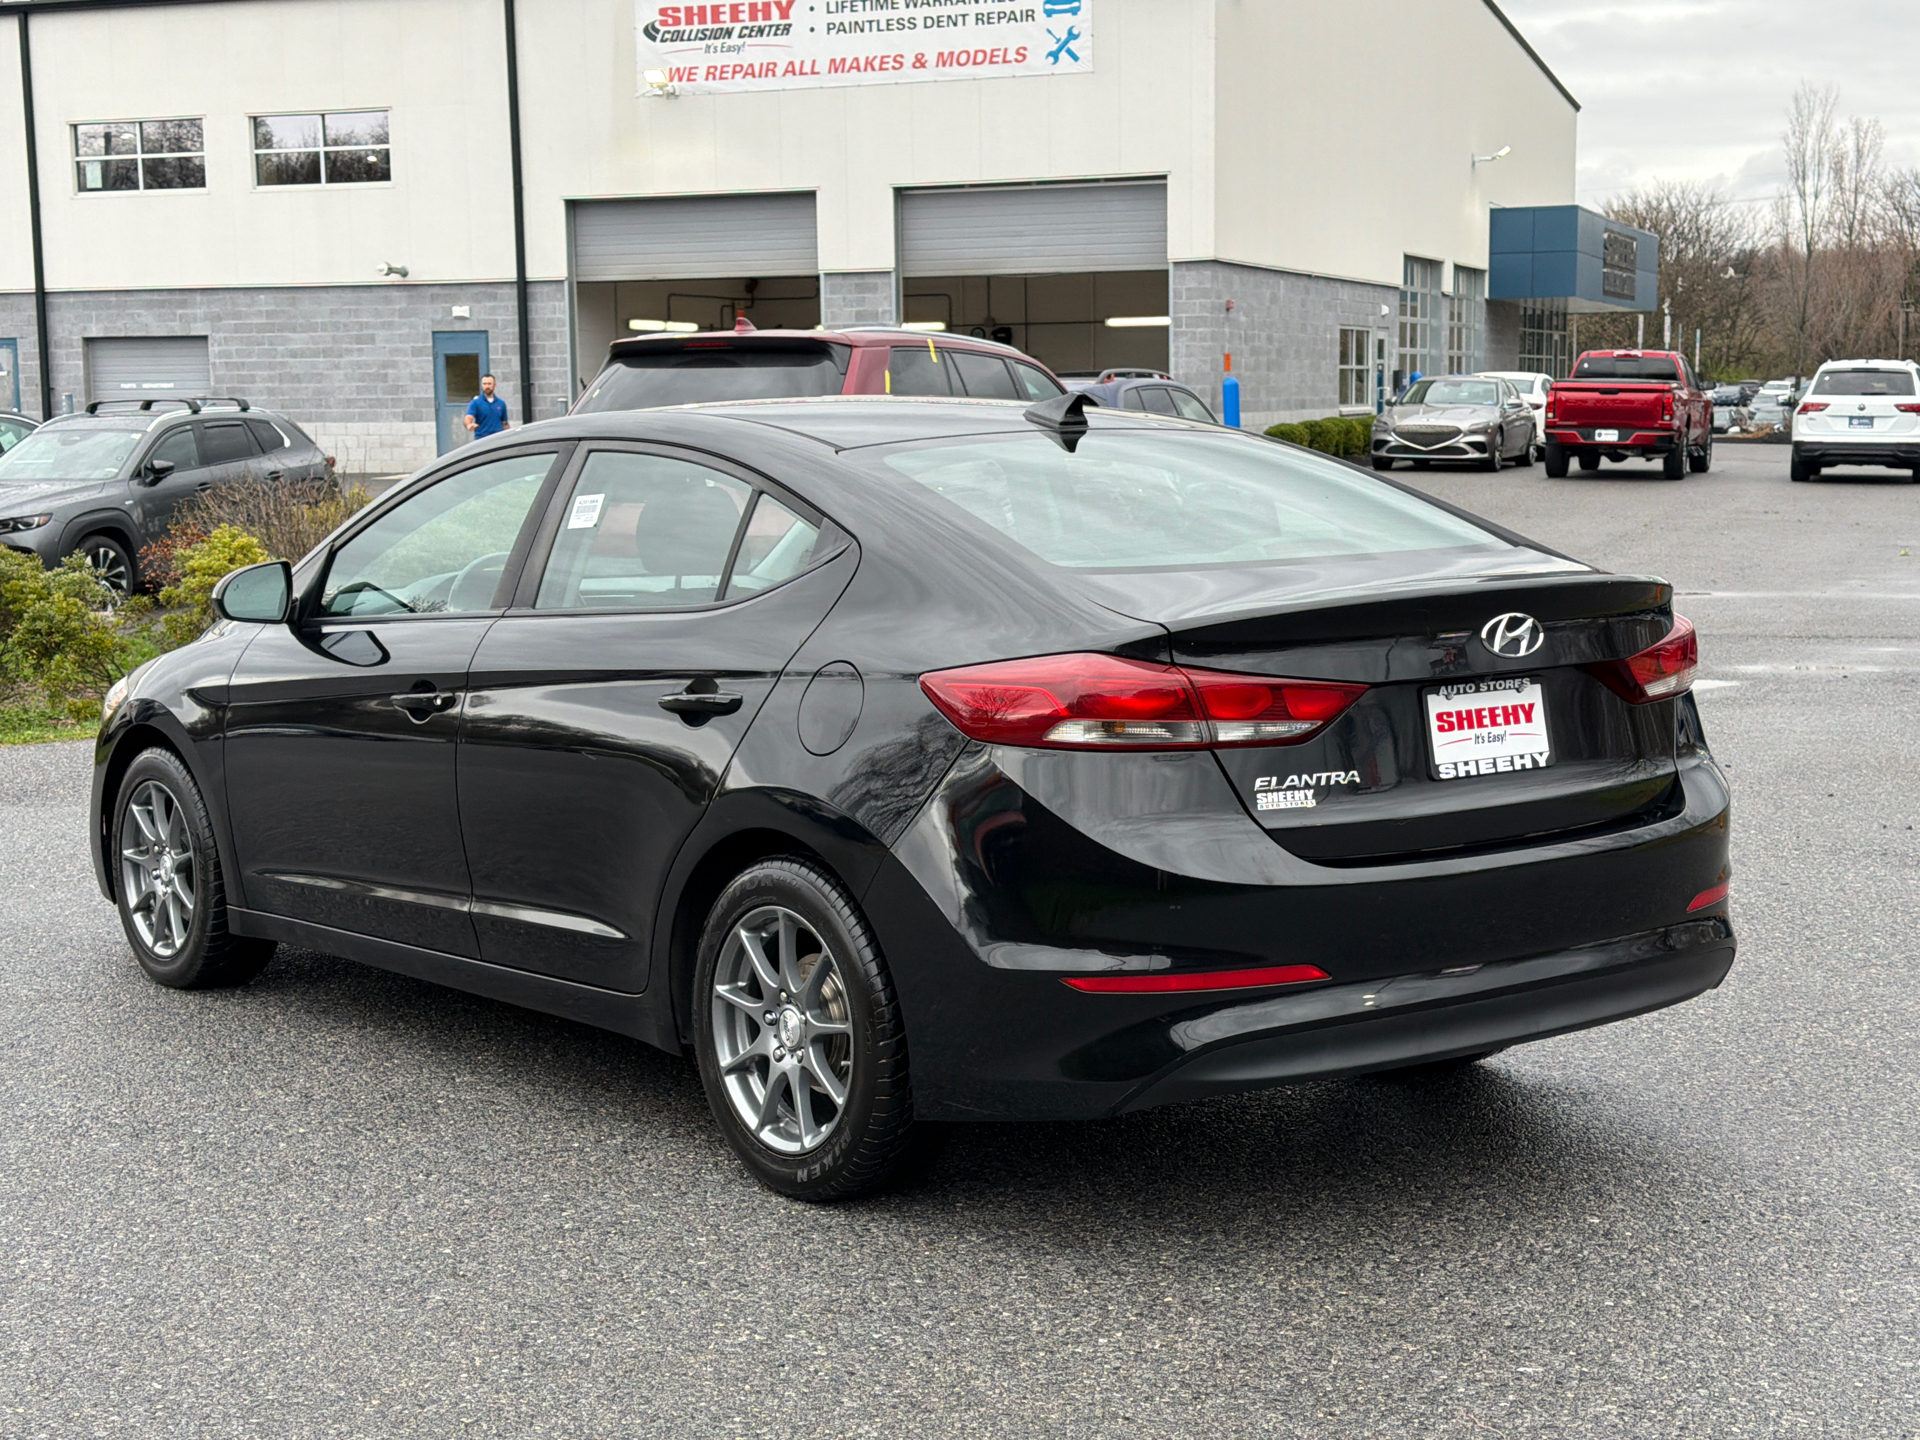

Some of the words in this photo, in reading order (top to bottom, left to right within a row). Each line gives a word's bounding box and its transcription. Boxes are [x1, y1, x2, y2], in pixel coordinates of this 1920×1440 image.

[658, 0, 797, 27] SHEEHY
[826, 0, 899, 14] LIFETIME
[826, 17, 917, 35] PAINTLESS
[923, 14, 969, 29] DENT
[974, 8, 1036, 26] REPAIR
[659, 26, 735, 43] COLLISION
[737, 23, 793, 39] CENTER
[704, 43, 718, 54] It's
[720, 41, 746, 54] Easy!
[667, 66, 700, 83] WE
[704, 61, 778, 82] REPAIR
[782, 59, 820, 77] ALL
[828, 54, 905, 75] MAKES
[911, 52, 928, 69] &
[935, 46, 1028, 68] MODELS
[1438, 683, 1476, 696] AUTO
[1479, 677, 1531, 693] STORES
[1435, 702, 1536, 733] SHEEHY
[1474, 733, 1486, 745] It's
[1487, 730, 1507, 746] Easy!
[1438, 751, 1551, 780] SHEEHY
[1253, 770, 1361, 791] ELANTRA
[1256, 789, 1314, 805] SHEEHY
